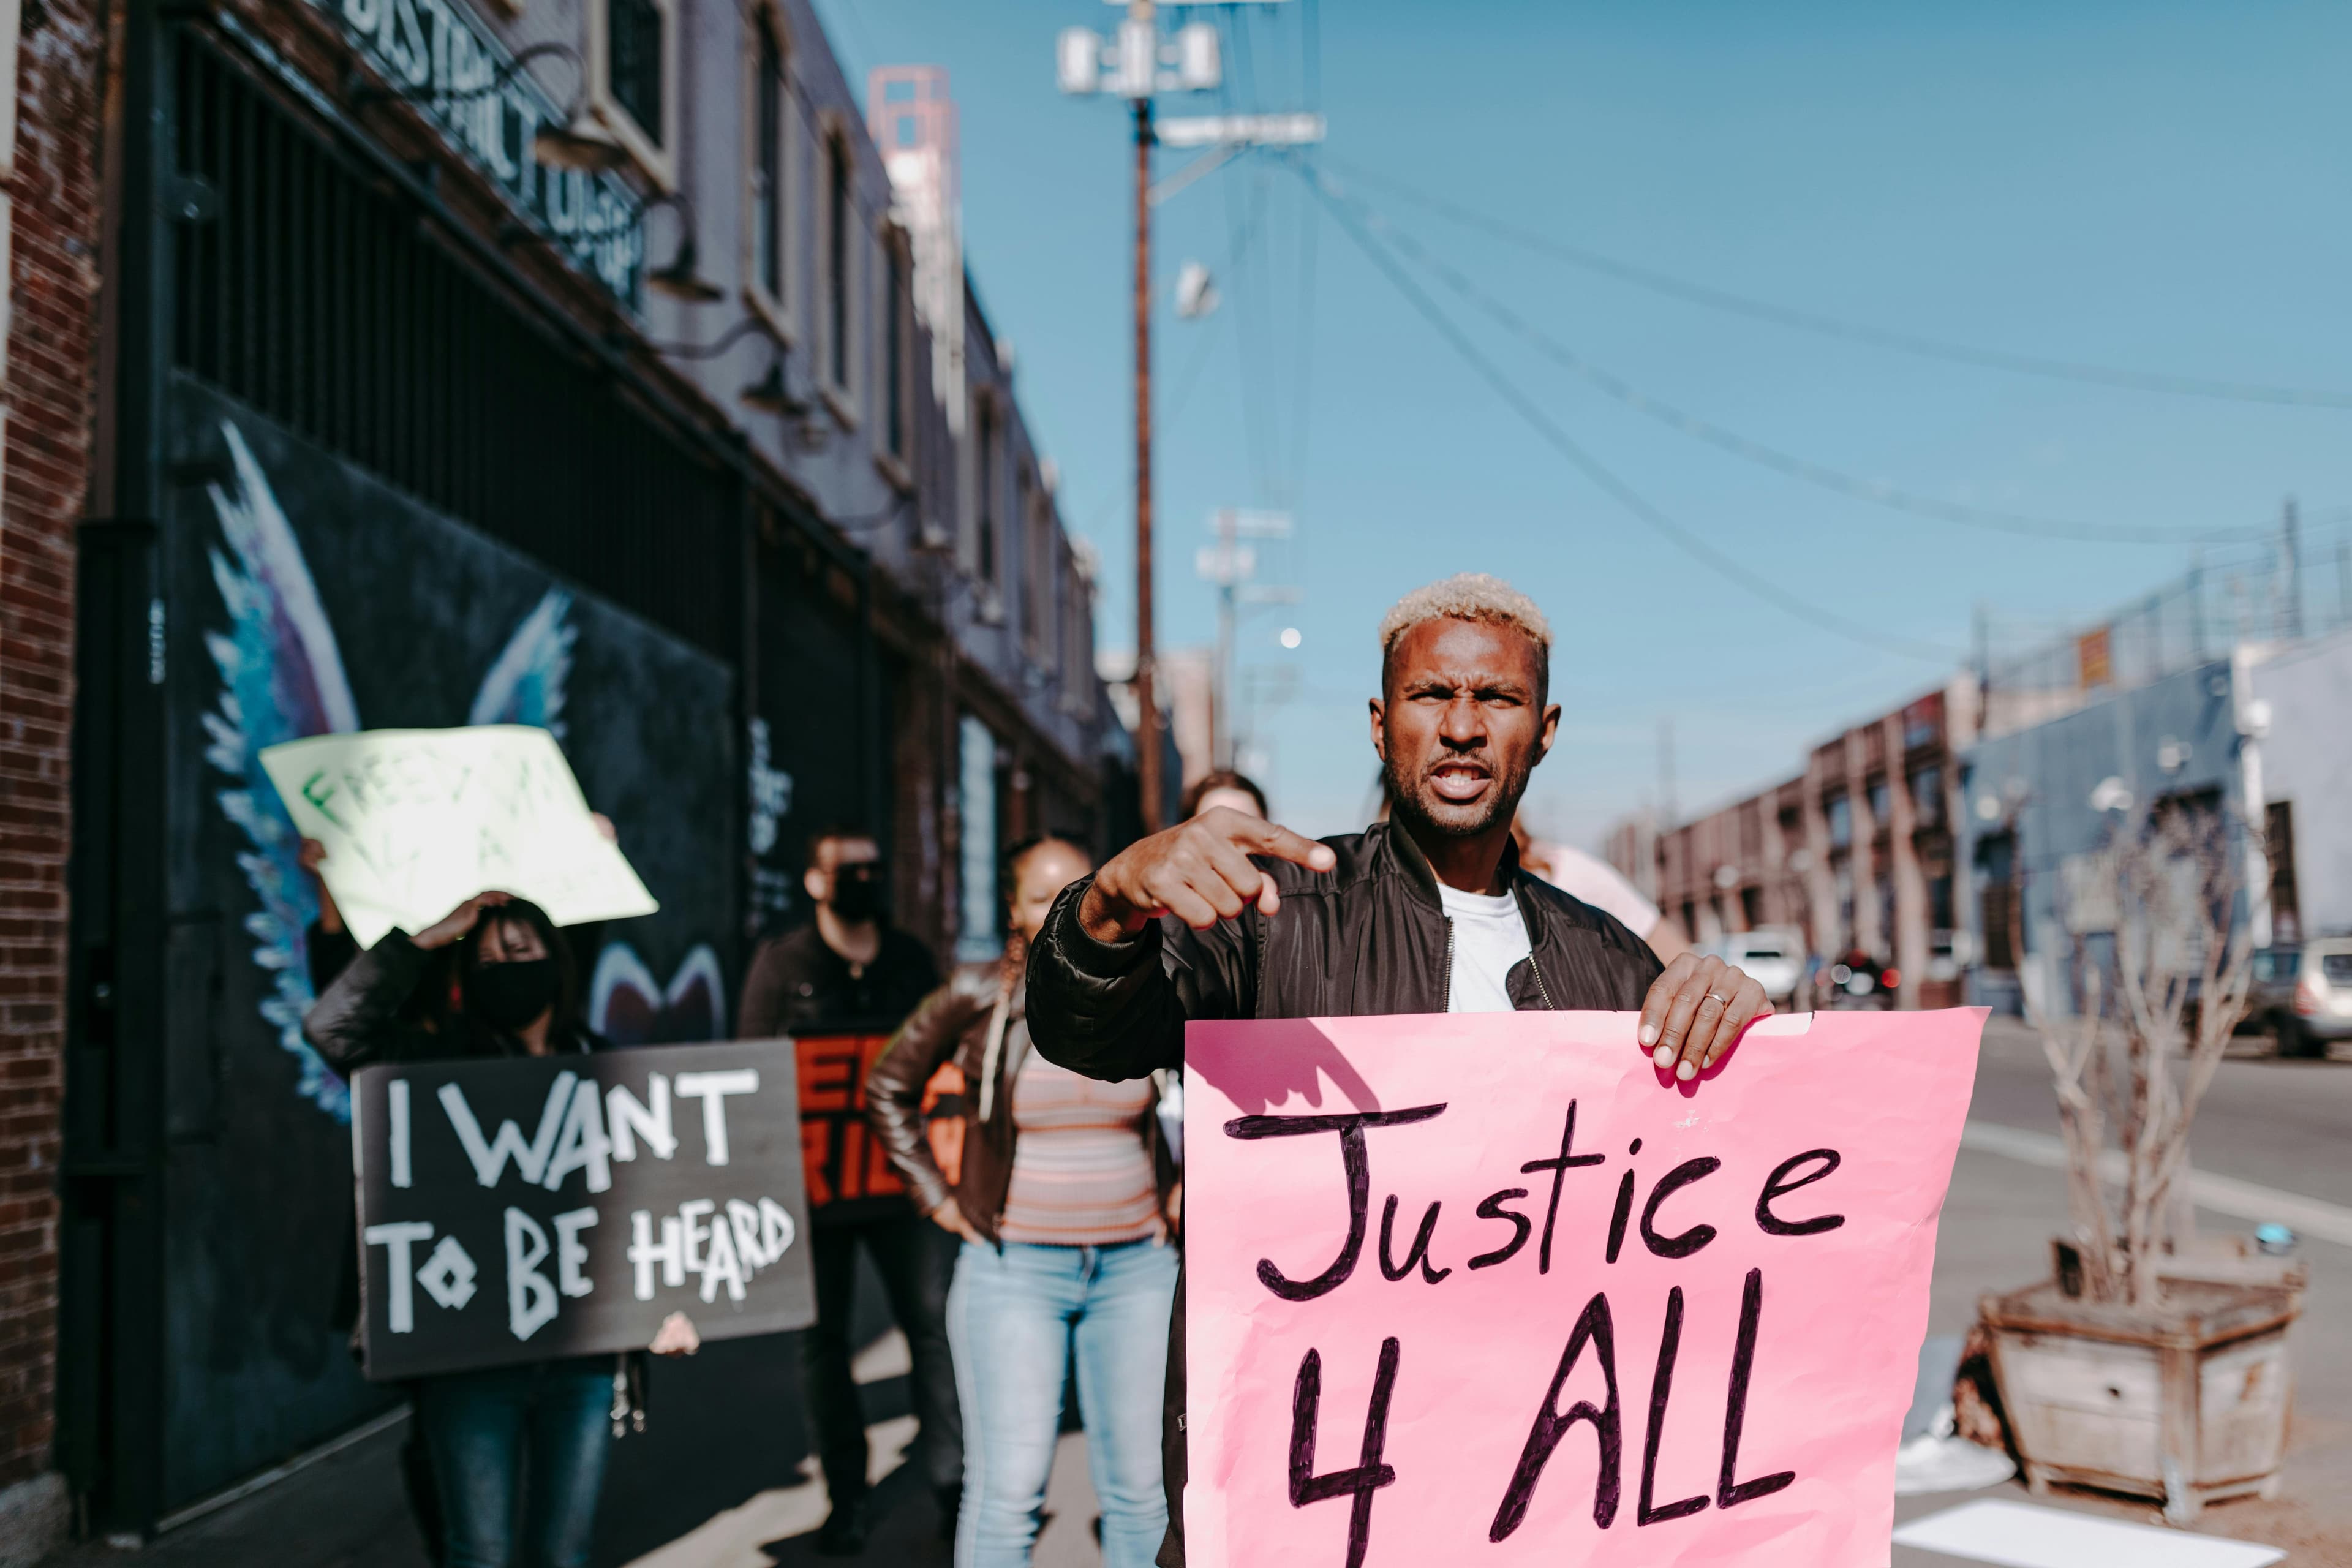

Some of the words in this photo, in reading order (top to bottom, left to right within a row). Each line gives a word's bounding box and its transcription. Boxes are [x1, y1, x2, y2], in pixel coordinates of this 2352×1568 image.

[388, 1079, 411, 1187] I
[439, 1068, 760, 1193] WANT
[1223, 1099, 1845, 1302] Justice
[364, 1222, 477, 1333] TO
[505, 1207, 598, 1340] BE
[626, 1196, 795, 1303] HEARD
[1287, 1336, 1400, 1568] 4
[1488, 1267, 1796, 1544] ALL
